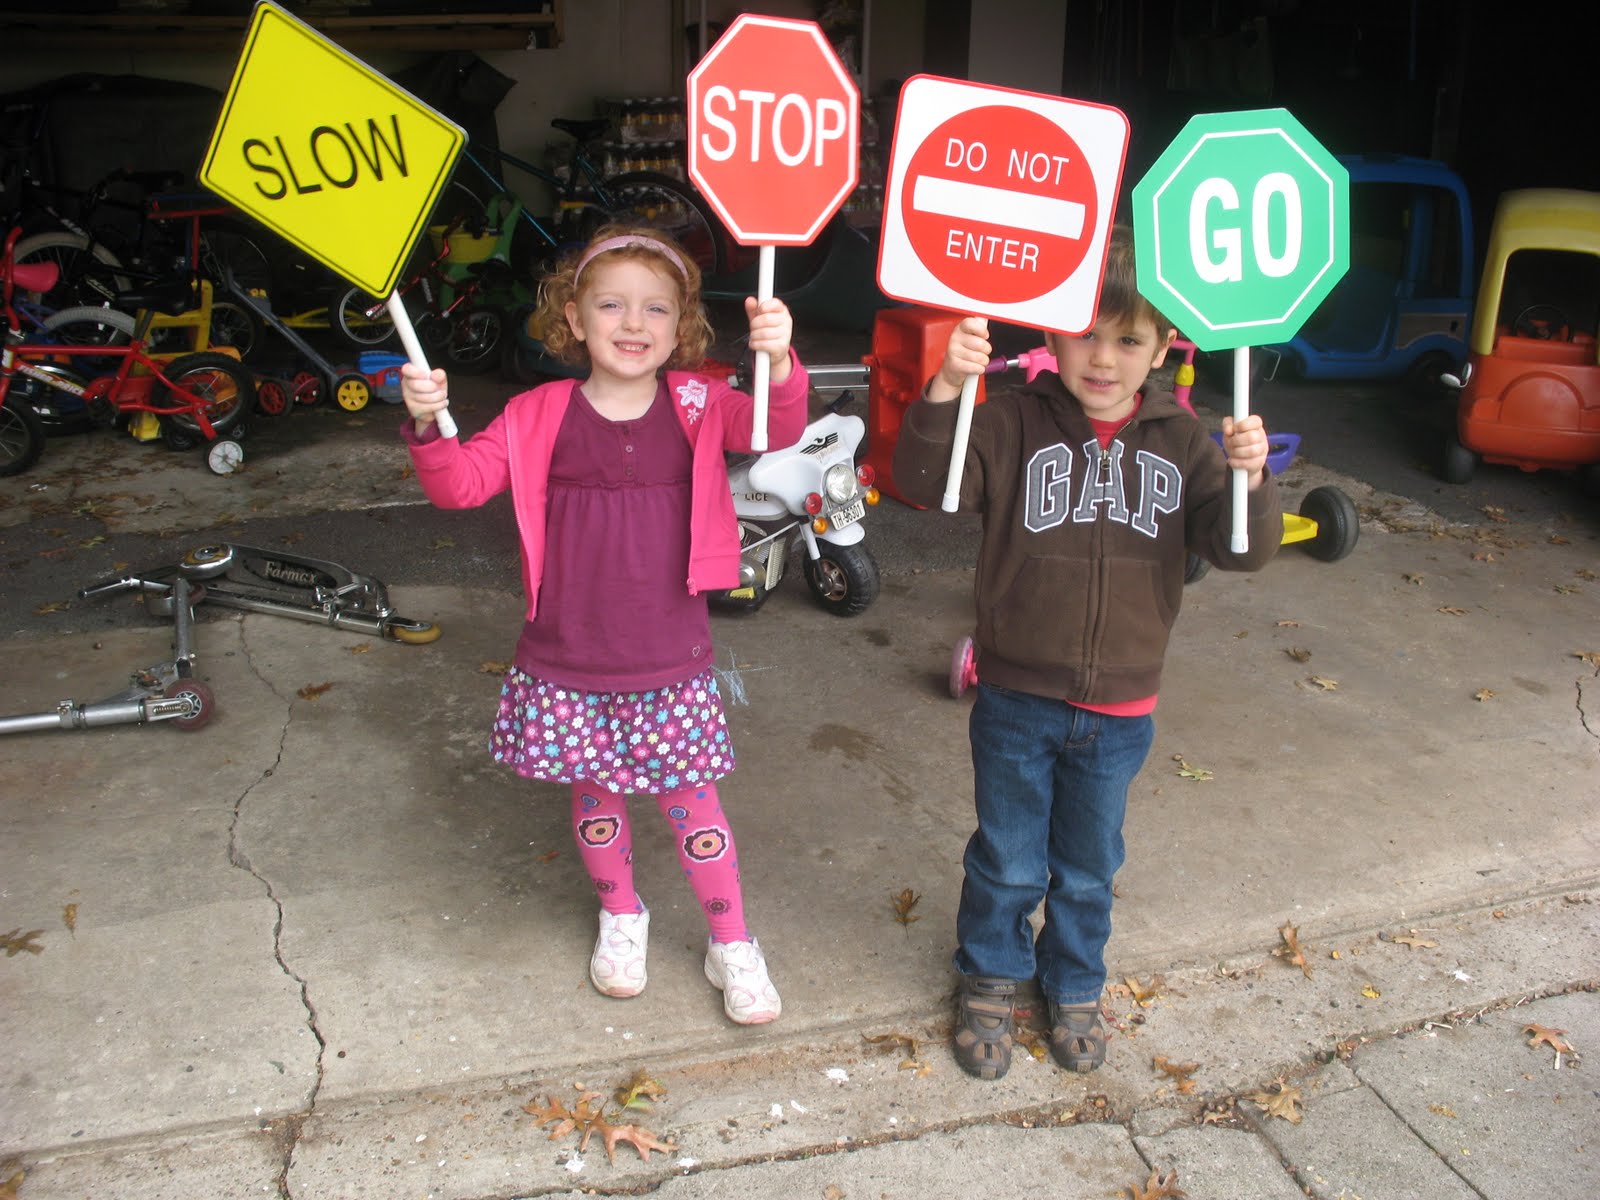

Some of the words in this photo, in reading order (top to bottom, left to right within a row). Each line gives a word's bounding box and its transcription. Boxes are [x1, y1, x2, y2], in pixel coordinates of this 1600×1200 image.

[242, 114, 408, 200] SLOW
[702, 85, 846, 167] STOP
[945, 137, 987, 172] DO
[1007, 148, 1069, 185] NOT
[946, 229, 1039, 272] ENTER
[1189, 171, 1302, 283] GO
[732, 491, 769, 502] LICE
[1024, 438, 1182, 538] GAP
